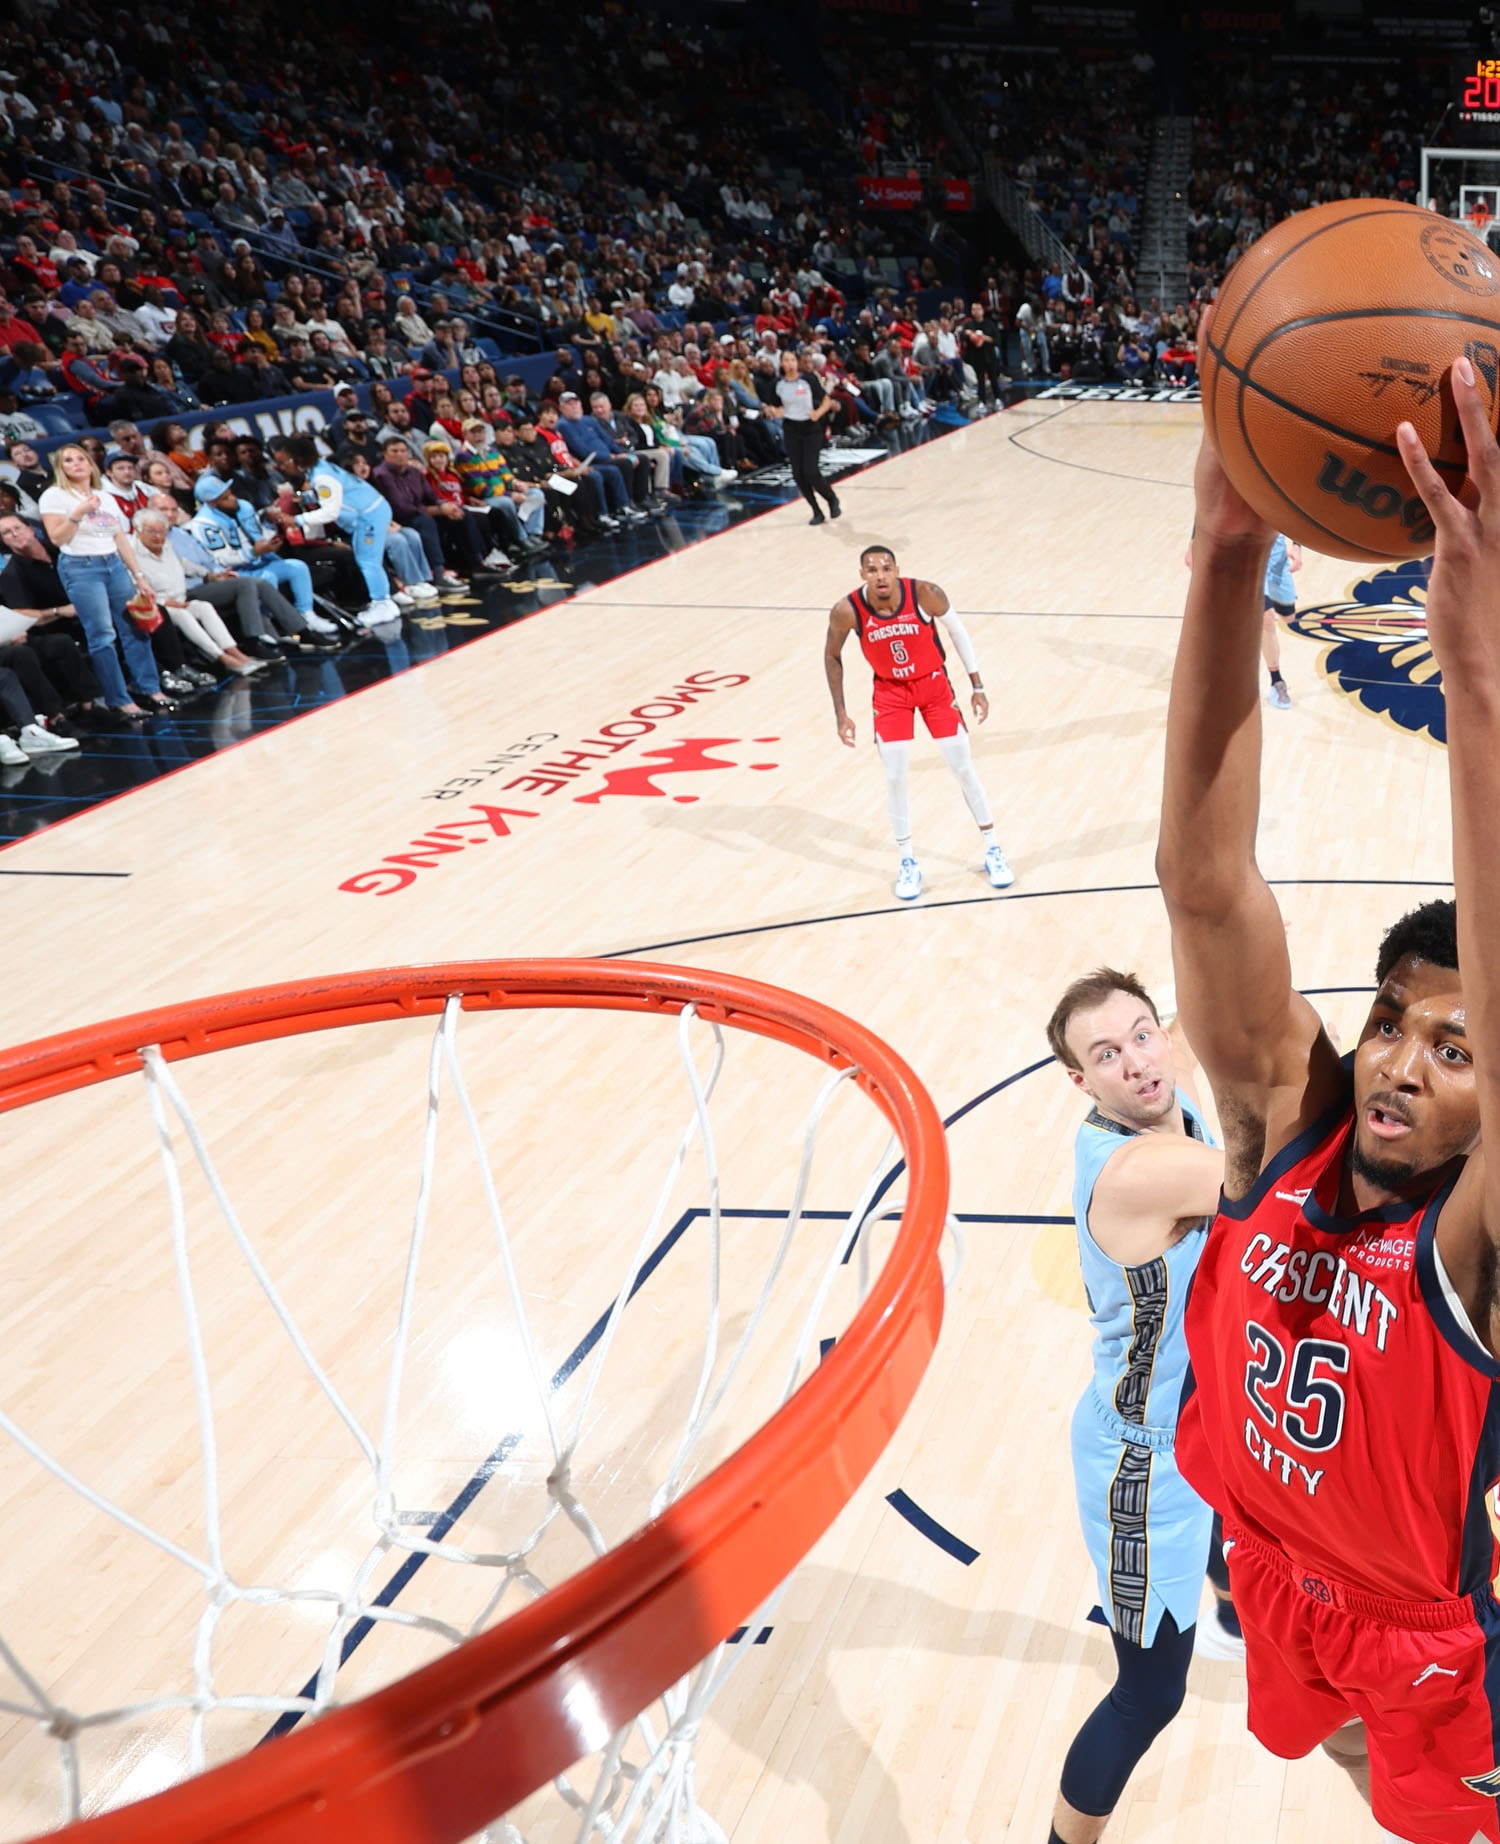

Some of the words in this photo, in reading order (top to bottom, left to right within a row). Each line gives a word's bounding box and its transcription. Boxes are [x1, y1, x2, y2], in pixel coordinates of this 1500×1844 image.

[1036, 386, 1202, 403] PELIC
[868, 624, 919, 641] CRESCENT
[890, 641, 908, 664] 5
[892, 664, 915, 678] CITY
[501, 670, 750, 797] SMOOTHIE
[421, 732, 559, 801] CENTER
[1348, 1244, 1411, 1271] PRODUCTS
[1244, 1319, 1349, 1453] 25
[1244, 1416, 1324, 1496] CITY
